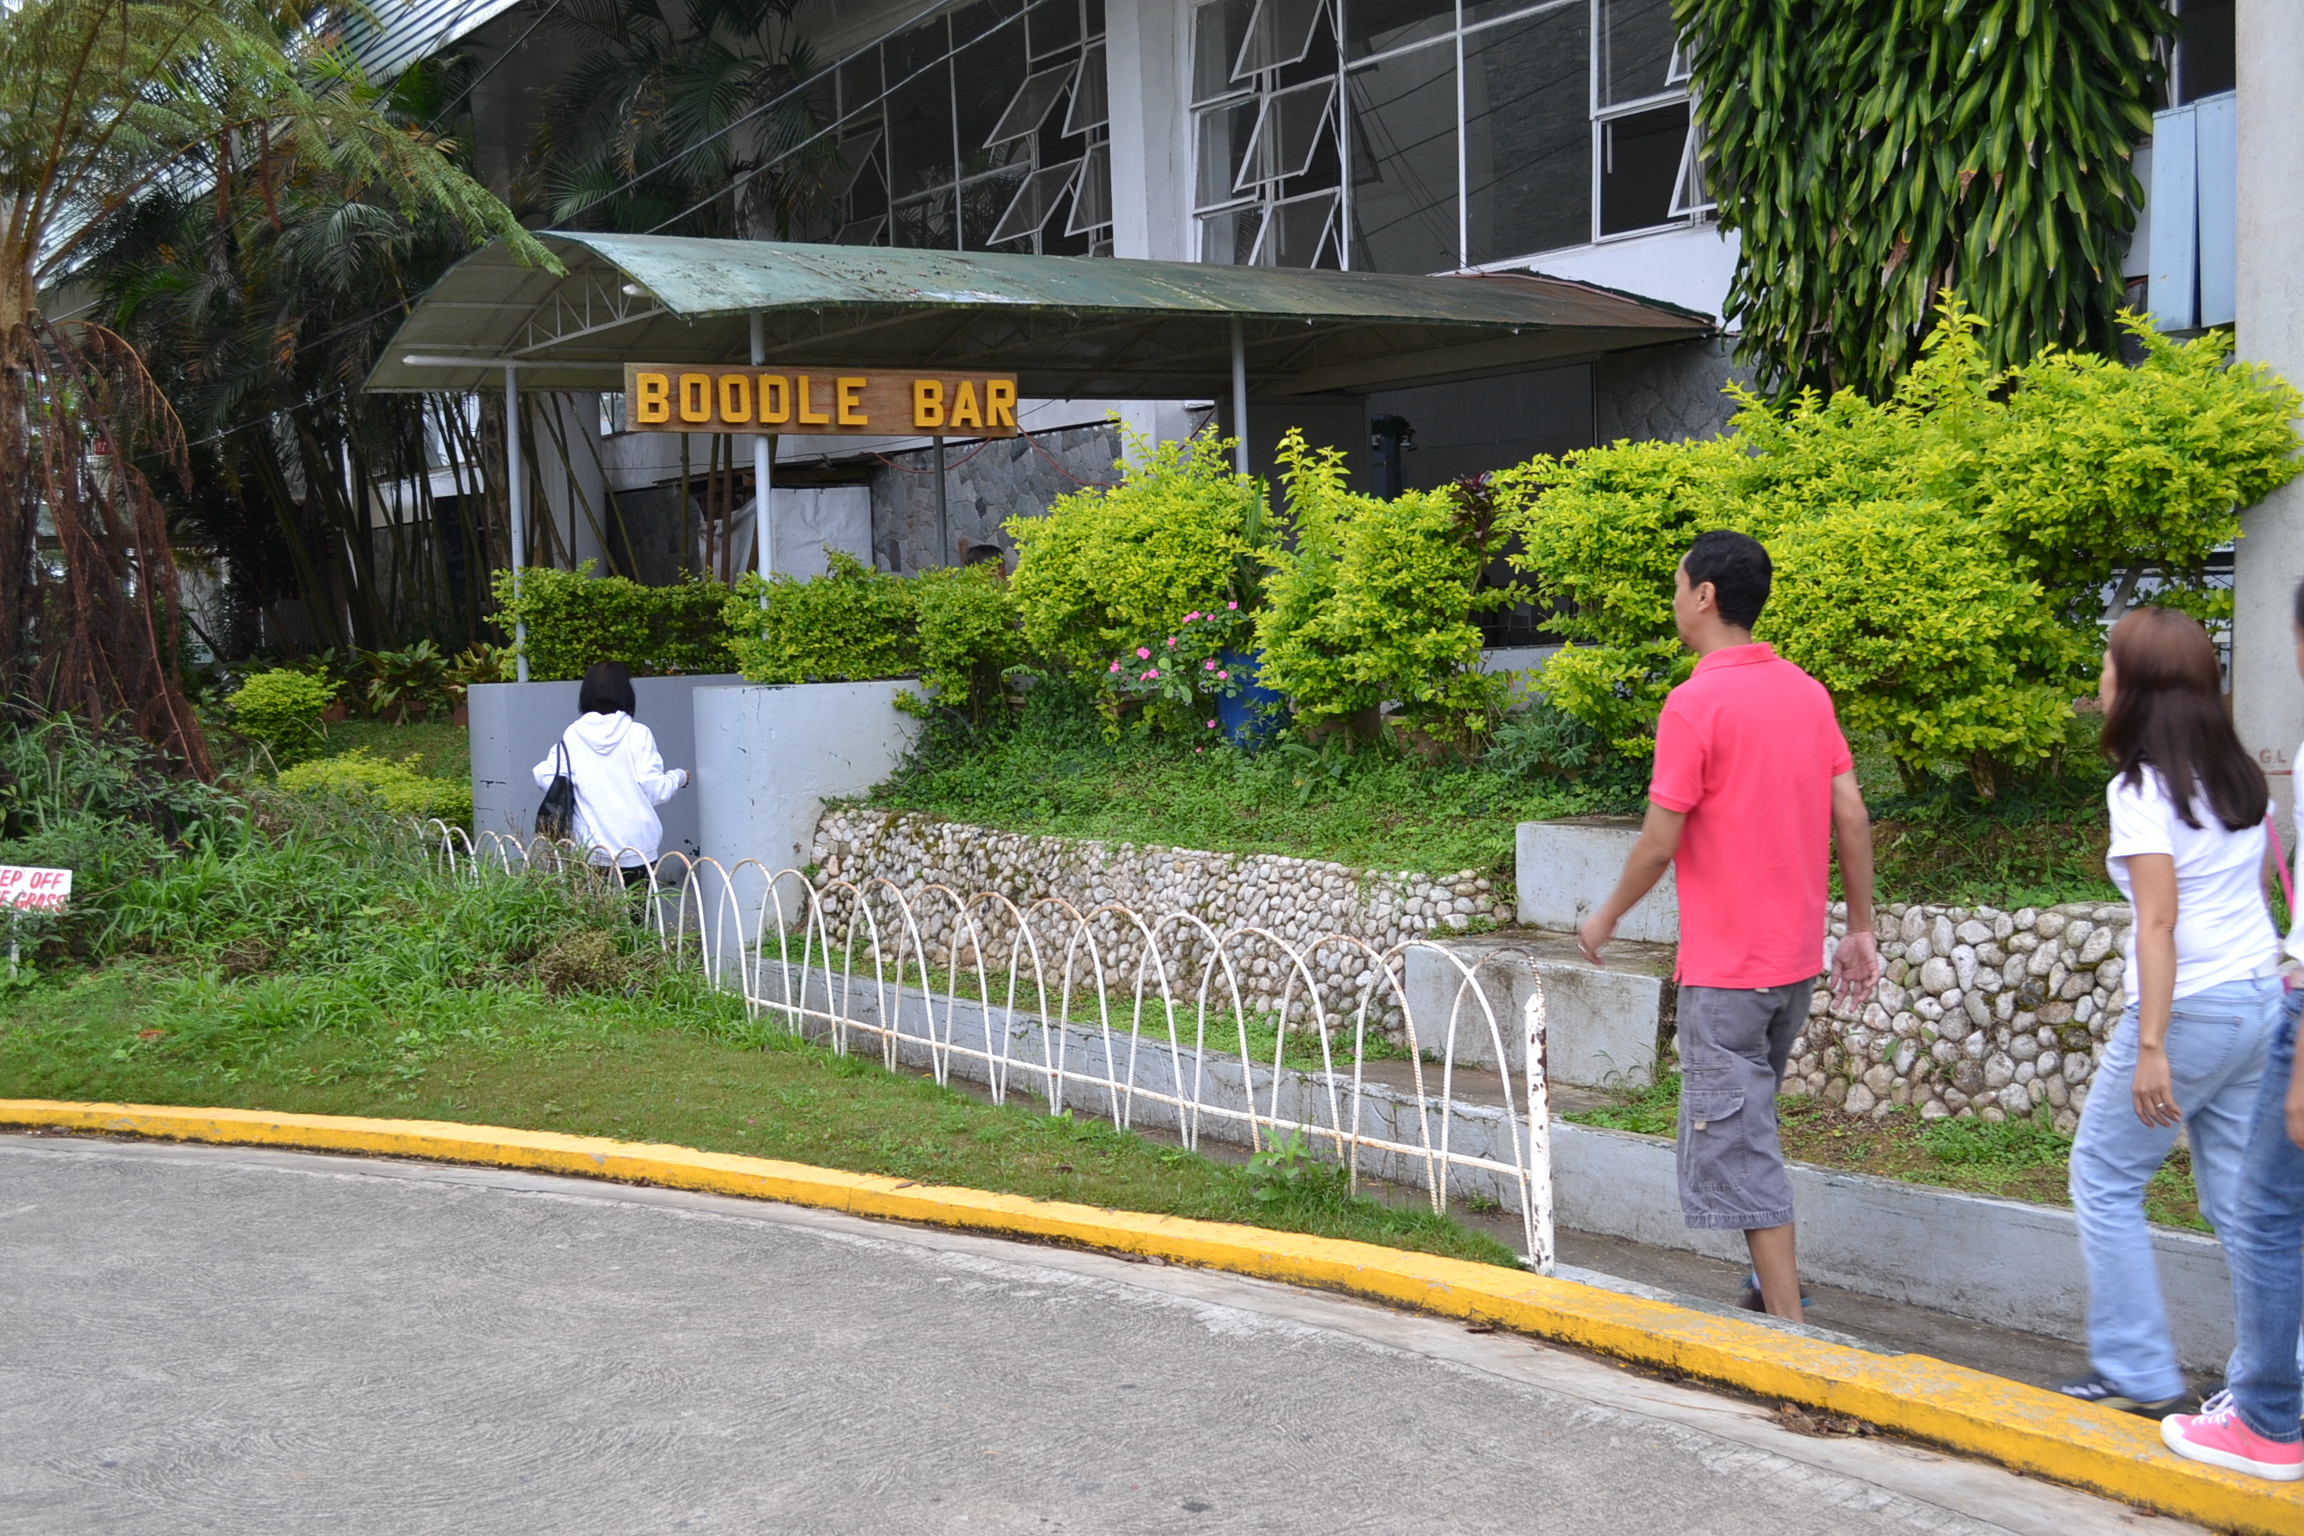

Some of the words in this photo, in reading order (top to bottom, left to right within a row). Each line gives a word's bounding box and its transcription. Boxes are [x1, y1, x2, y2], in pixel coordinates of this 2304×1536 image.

[636, 373, 868, 425] BOODLE
[913, 379, 1015, 427] BAR
[0, 869, 23, 887] EP
[29, 871, 65, 890] OFF
